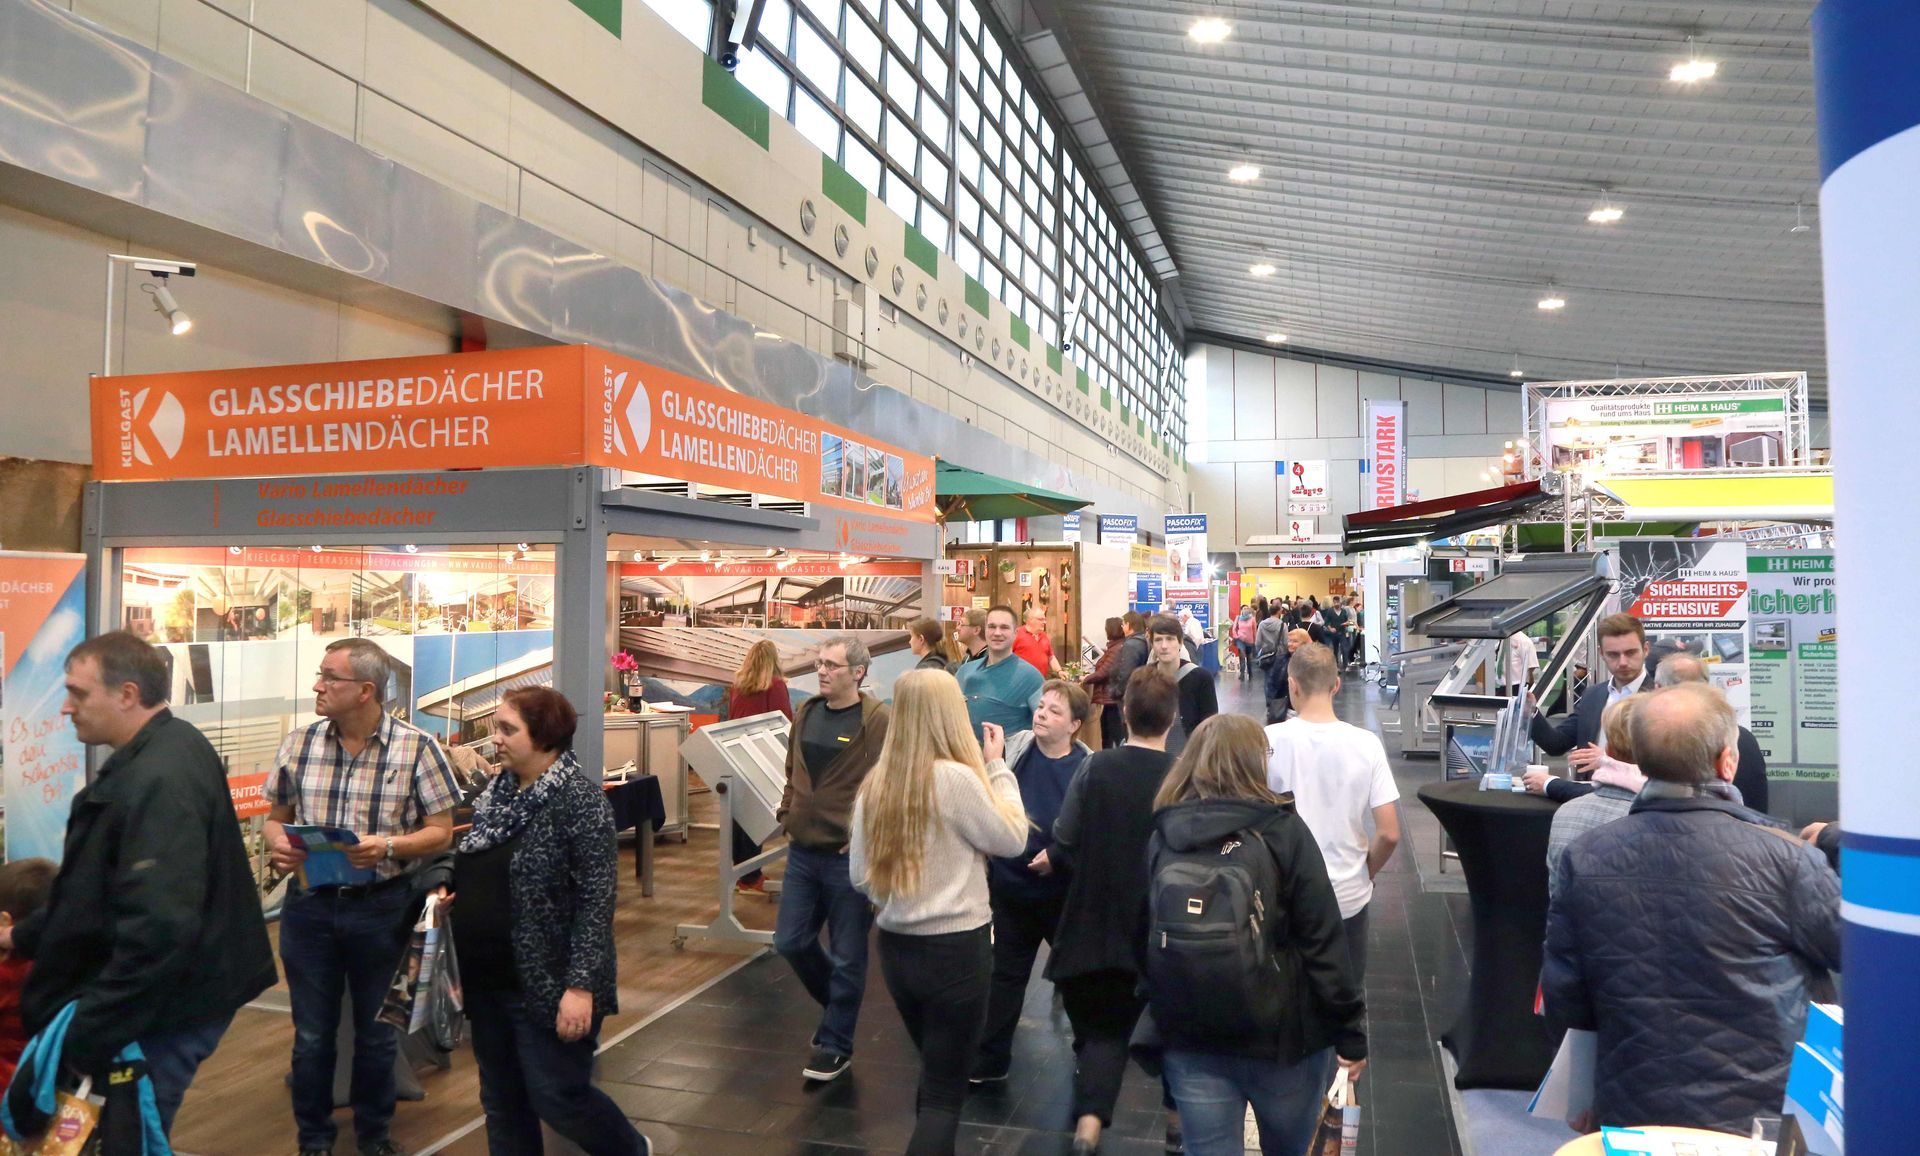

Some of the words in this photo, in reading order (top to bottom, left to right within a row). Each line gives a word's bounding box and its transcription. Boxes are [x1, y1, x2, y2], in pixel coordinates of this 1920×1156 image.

[208, 369, 545, 417] GLASSCHIEBEDÄCHER
[604, 364, 614, 454] KIELGAST
[1590, 403, 1651, 412] Qualitätsprodukte
[1675, 404, 1699, 412] HEIM
[1701, 403, 1709, 412] &
[1711, 402, 1736, 411] HAUS
[121, 387, 132, 468] KIELGAST
[661, 390, 818, 455] GLASSCHIEBEDÄCHER
[207, 415, 490, 458] LAMELLENDÄCHER
[660, 430, 799, 484] LAMELLENDÄCHER
[258, 480, 307, 499] Vario
[311, 476, 470, 498] Lamellendächer
[256, 506, 437, 527] Glasschiebedächer
[1103, 518, 1133, 527] PASCOFIX
[1167, 517, 1202, 527] PASCOFIX
[1792, 559, 1825, 569] HEIM
[1649, 583, 1744, 597] SICHERHEITS-
[1793, 577, 1811, 586] Wir
[1642, 602, 1720, 616] OFFENSIVE
[1748, 588, 1836, 615] icherh
[1795, 769, 1830, 779] Montage
